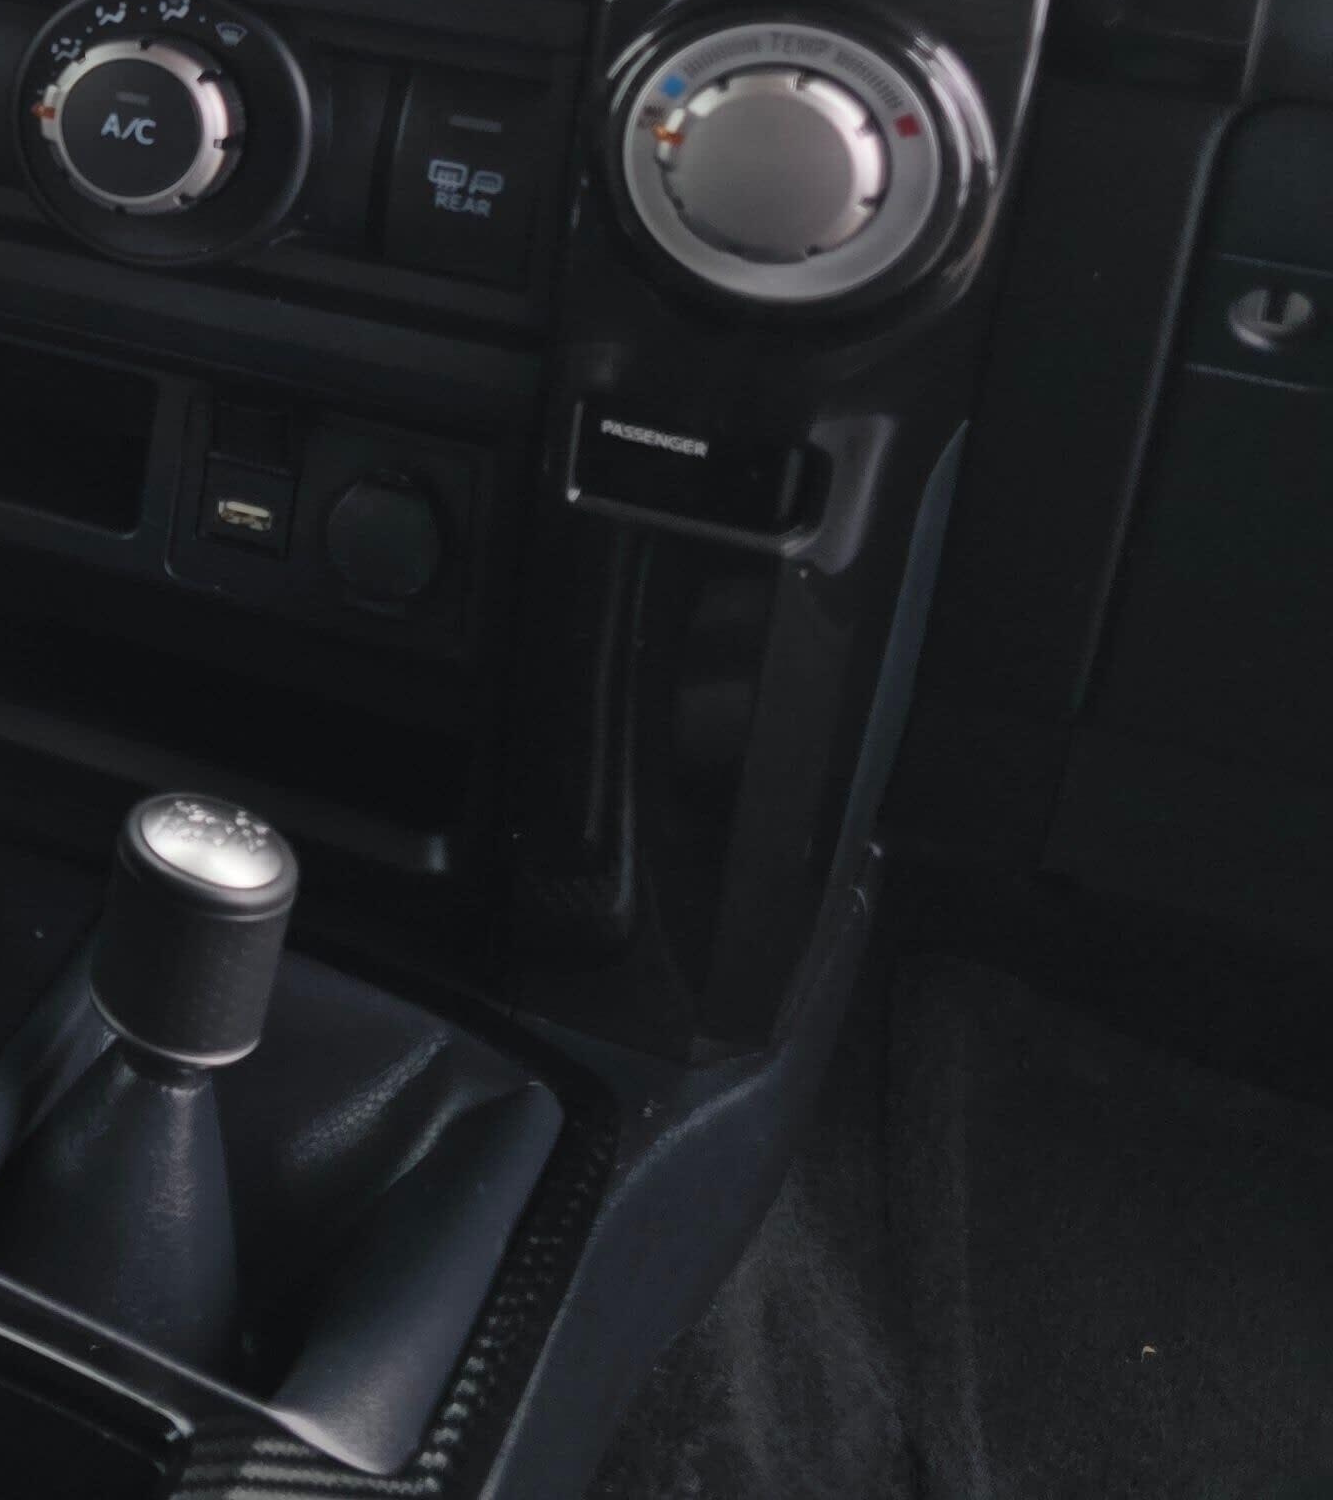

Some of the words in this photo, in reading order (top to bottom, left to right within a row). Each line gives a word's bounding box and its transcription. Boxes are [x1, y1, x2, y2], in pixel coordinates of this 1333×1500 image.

[100, 113, 157, 146] A/C
[434, 190, 491, 219] REAR
[600, 418, 709, 459] PASSENGER
